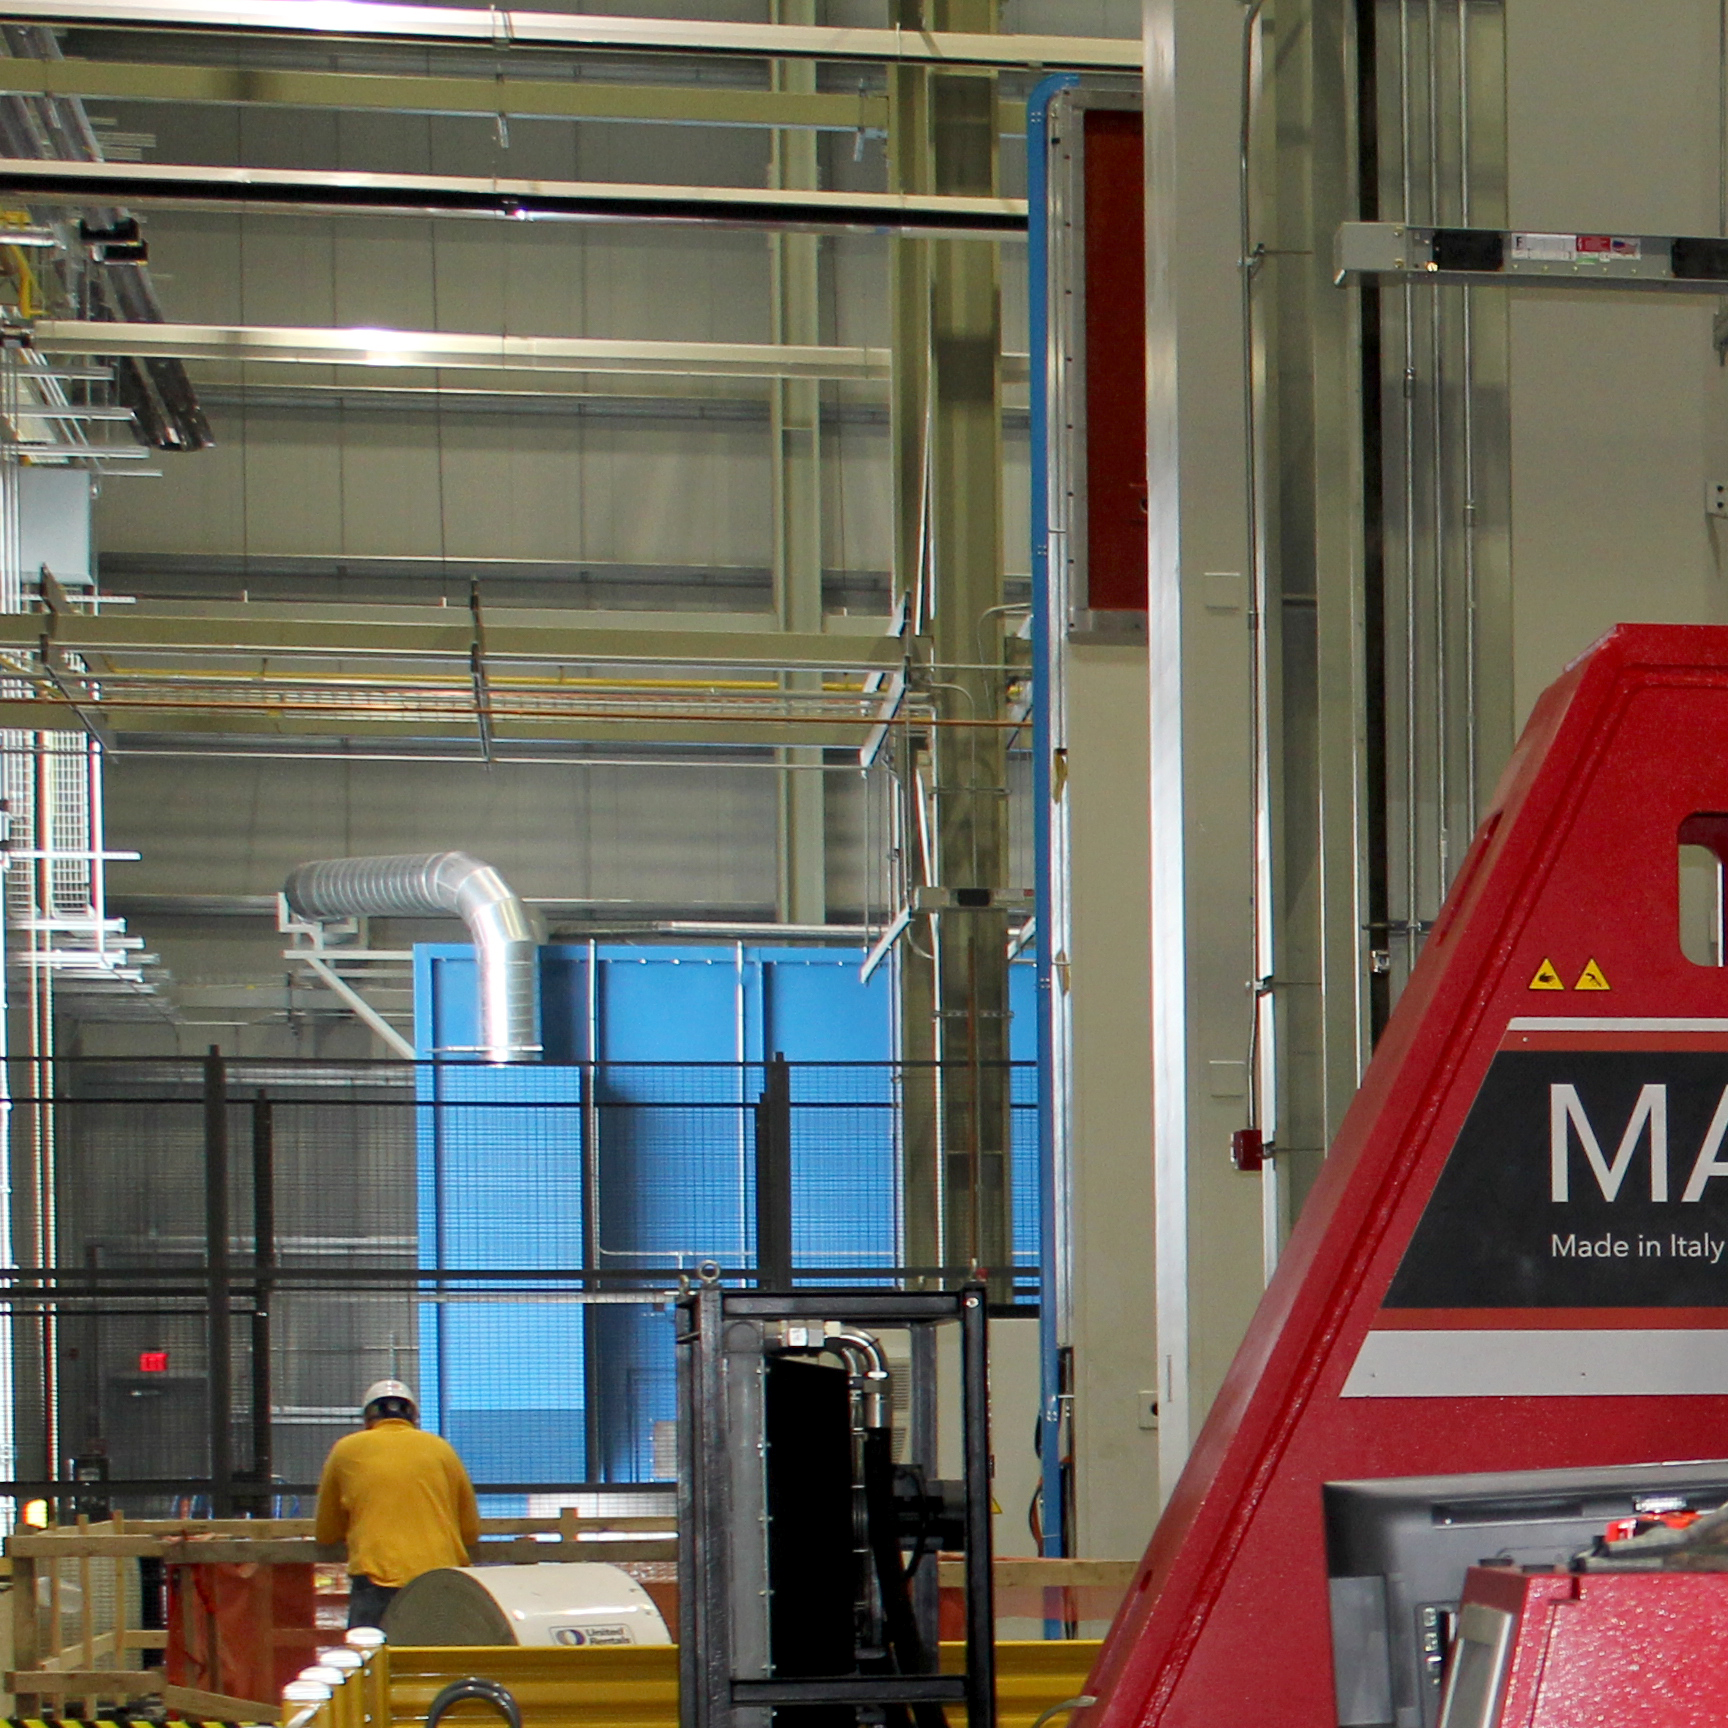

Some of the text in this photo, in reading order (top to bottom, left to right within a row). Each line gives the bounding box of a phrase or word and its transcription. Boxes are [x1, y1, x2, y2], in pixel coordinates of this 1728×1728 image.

[1551, 1231, 1726, 1265] Made in Italy
